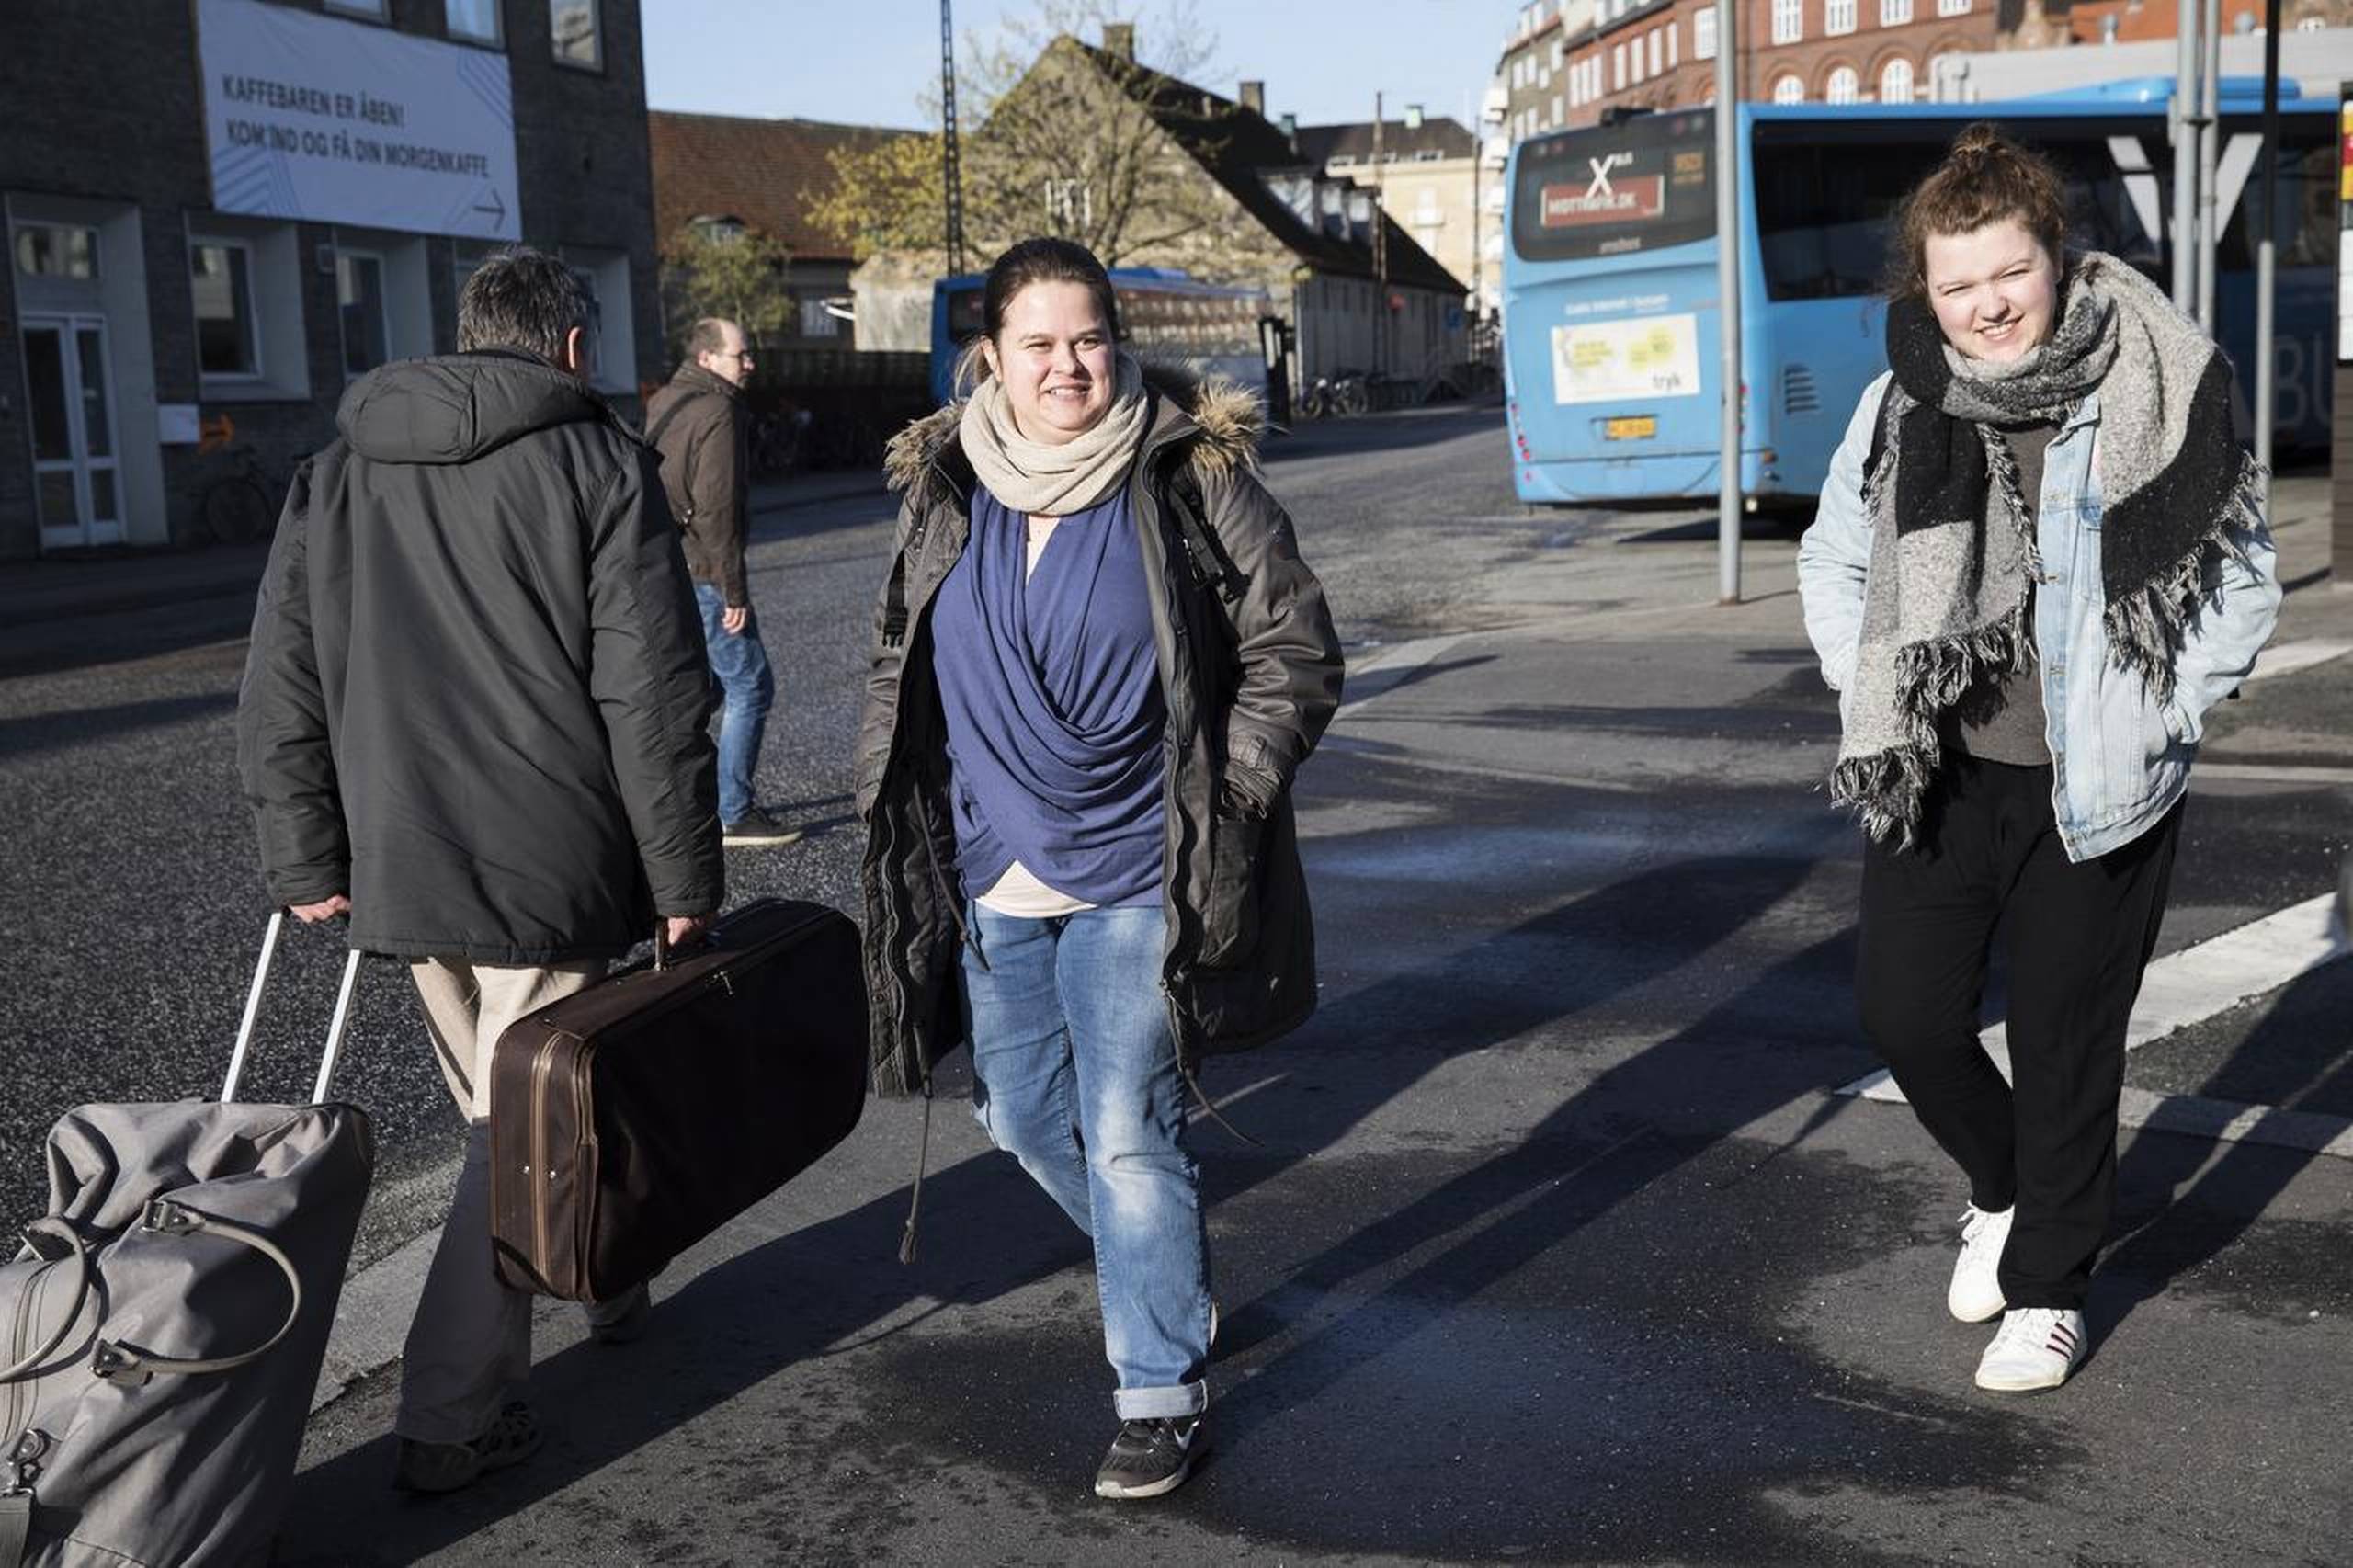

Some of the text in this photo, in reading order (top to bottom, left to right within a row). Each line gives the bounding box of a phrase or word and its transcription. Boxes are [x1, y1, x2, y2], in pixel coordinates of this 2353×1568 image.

[222, 74, 404, 127] KAFFEBAREN ER ÅBEN!
[226, 118, 489, 177] KOM IND OG FÅ DIN MORGENKAFFE
